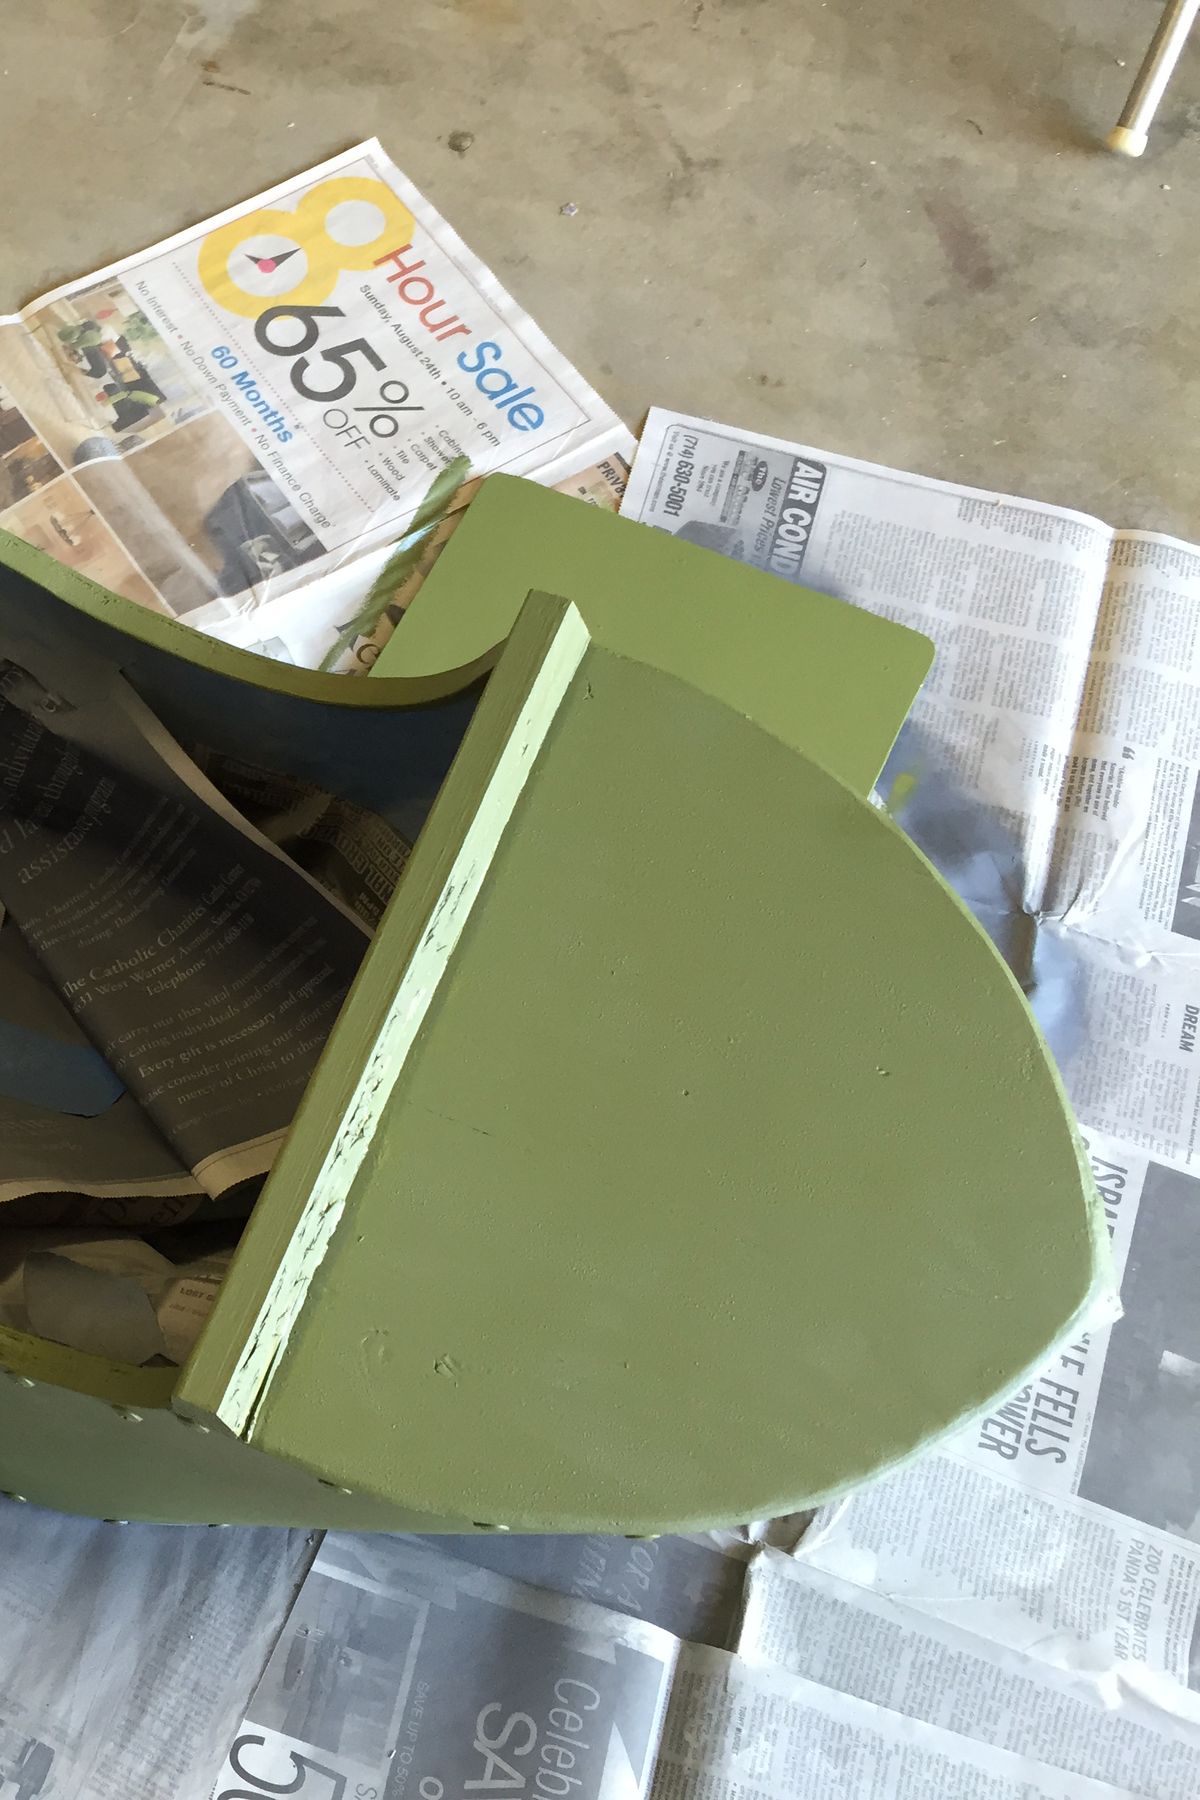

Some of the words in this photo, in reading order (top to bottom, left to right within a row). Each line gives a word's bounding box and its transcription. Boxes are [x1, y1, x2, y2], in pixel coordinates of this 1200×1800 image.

[356, 282, 394, 323] Sunday,
[372, 243, 472, 342] Hour
[456, 340, 545, 433] Sale
[388, 319, 423, 358] August
[134, 279, 152, 297] No
[146, 294, 179, 334] Interest
[180, 340, 195, 358] No
[191, 355, 217, 385] Down
[213, 381, 252, 428] Payment
[253, 432, 271, 451] No
[266, 448, 303, 493] Finance
[255, 304, 425, 439] 65%
[418, 354, 443, 380] 24th
[209, 341, 239, 372] 60
[229, 366, 296, 447] Months
[445, 386, 459, 400] 10
[455, 399, 472, 417] am
[322, 407, 371, 452] OFF
[475, 420, 486, 431] 6
[479, 428, 500, 450] pm
[677, 433, 699, 460] (714)
[381, 455, 405, 483] Wood
[395, 449, 410, 466] Tile
[408, 440, 437, 474] Carpet
[366, 461, 401, 504] Laminate
[662, 458, 695, 518] 630-5001
[762, 476, 787, 518] Lowest
[786, 461, 823, 505] AIR
[752, 516, 775, 554] Prices
[85, 933, 160, 991] Catholic
[128, 949, 179, 989] Warner
[141, 951, 211, 1004] Telephone
[169, 1000, 243, 1046] individuals
[238, 989, 266, 1009] and
[175, 1000, 203, 1022] this
[199, 984, 232, 1010] vital
[135, 1048, 180, 1082] Every
[177, 1043, 204, 1065] gift
[216, 1010, 278, 1049] necessary
[273, 991, 300, 1015] and
[1178, 1004, 1200, 1052] DREAM
[165, 1056, 222, 1095] consider
[220, 1034, 273, 1074] joining
[270, 1026, 296, 1047] our
[175, 1079, 216, 1109] mercy
[232, 1053, 279, 1089] Christ
[1022, 1376, 1082, 1464] FELLS
[1118, 1537, 1146, 1598] PANDA'S
[1143, 1544, 1164, 1575] ZOO
[1124, 1576, 1163, 1662] CELEBRATES
[1108, 1625, 1134, 1661] YEAR
[410, 1680, 430, 1719] SAVE
[407, 1719, 424, 1743] UP
[464, 1702, 538, 1800] SA
[532, 1678, 601, 1800] Celeb
[399, 1744, 416, 1767] TO
